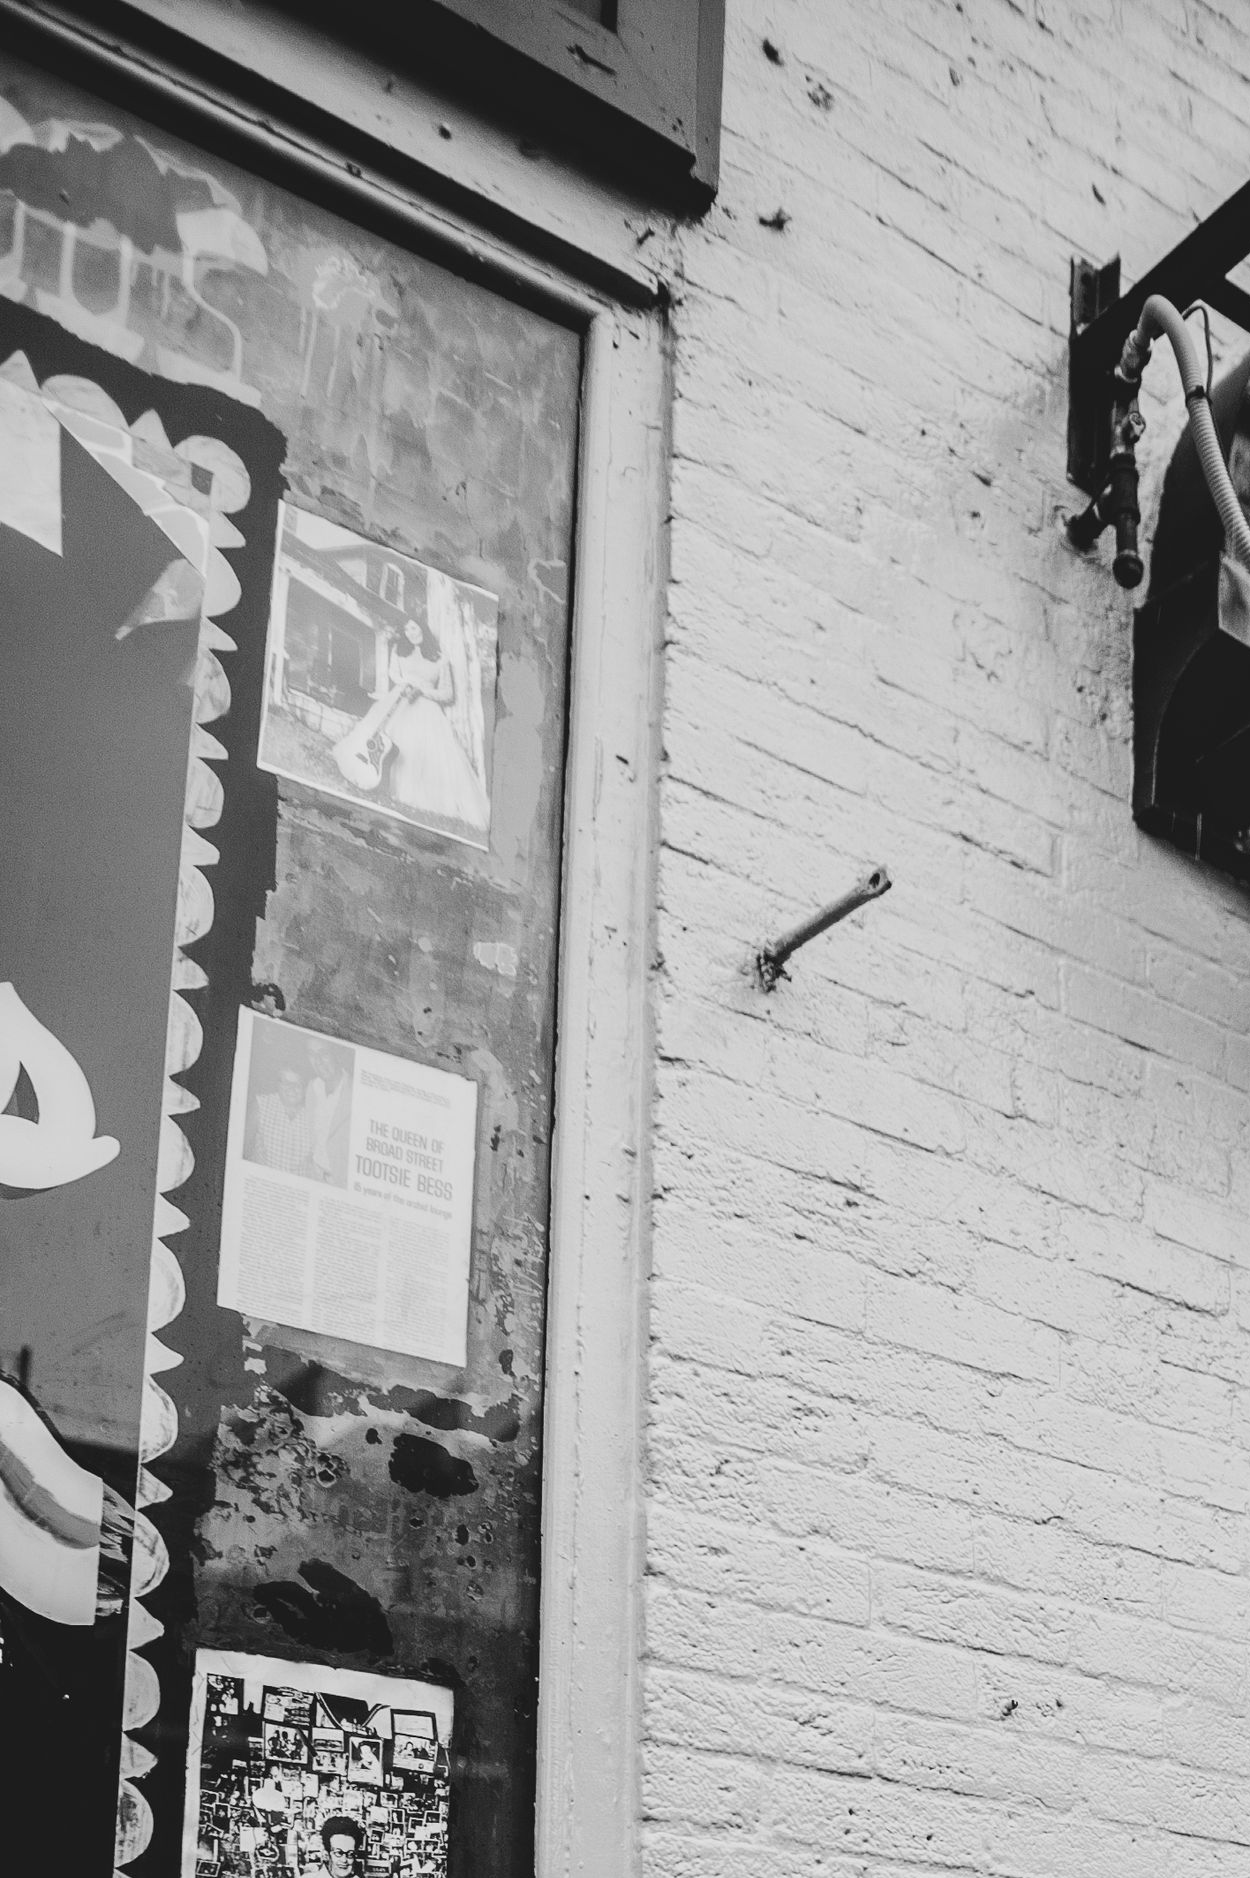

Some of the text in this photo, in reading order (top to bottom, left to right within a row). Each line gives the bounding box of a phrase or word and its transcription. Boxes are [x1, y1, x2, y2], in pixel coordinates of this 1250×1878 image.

[366, 1136, 443, 1173] BROAD STREET
[369, 1119, 444, 1154] THE QUEEN OF
[355, 1154, 453, 1201] TOOTSIE BESS
